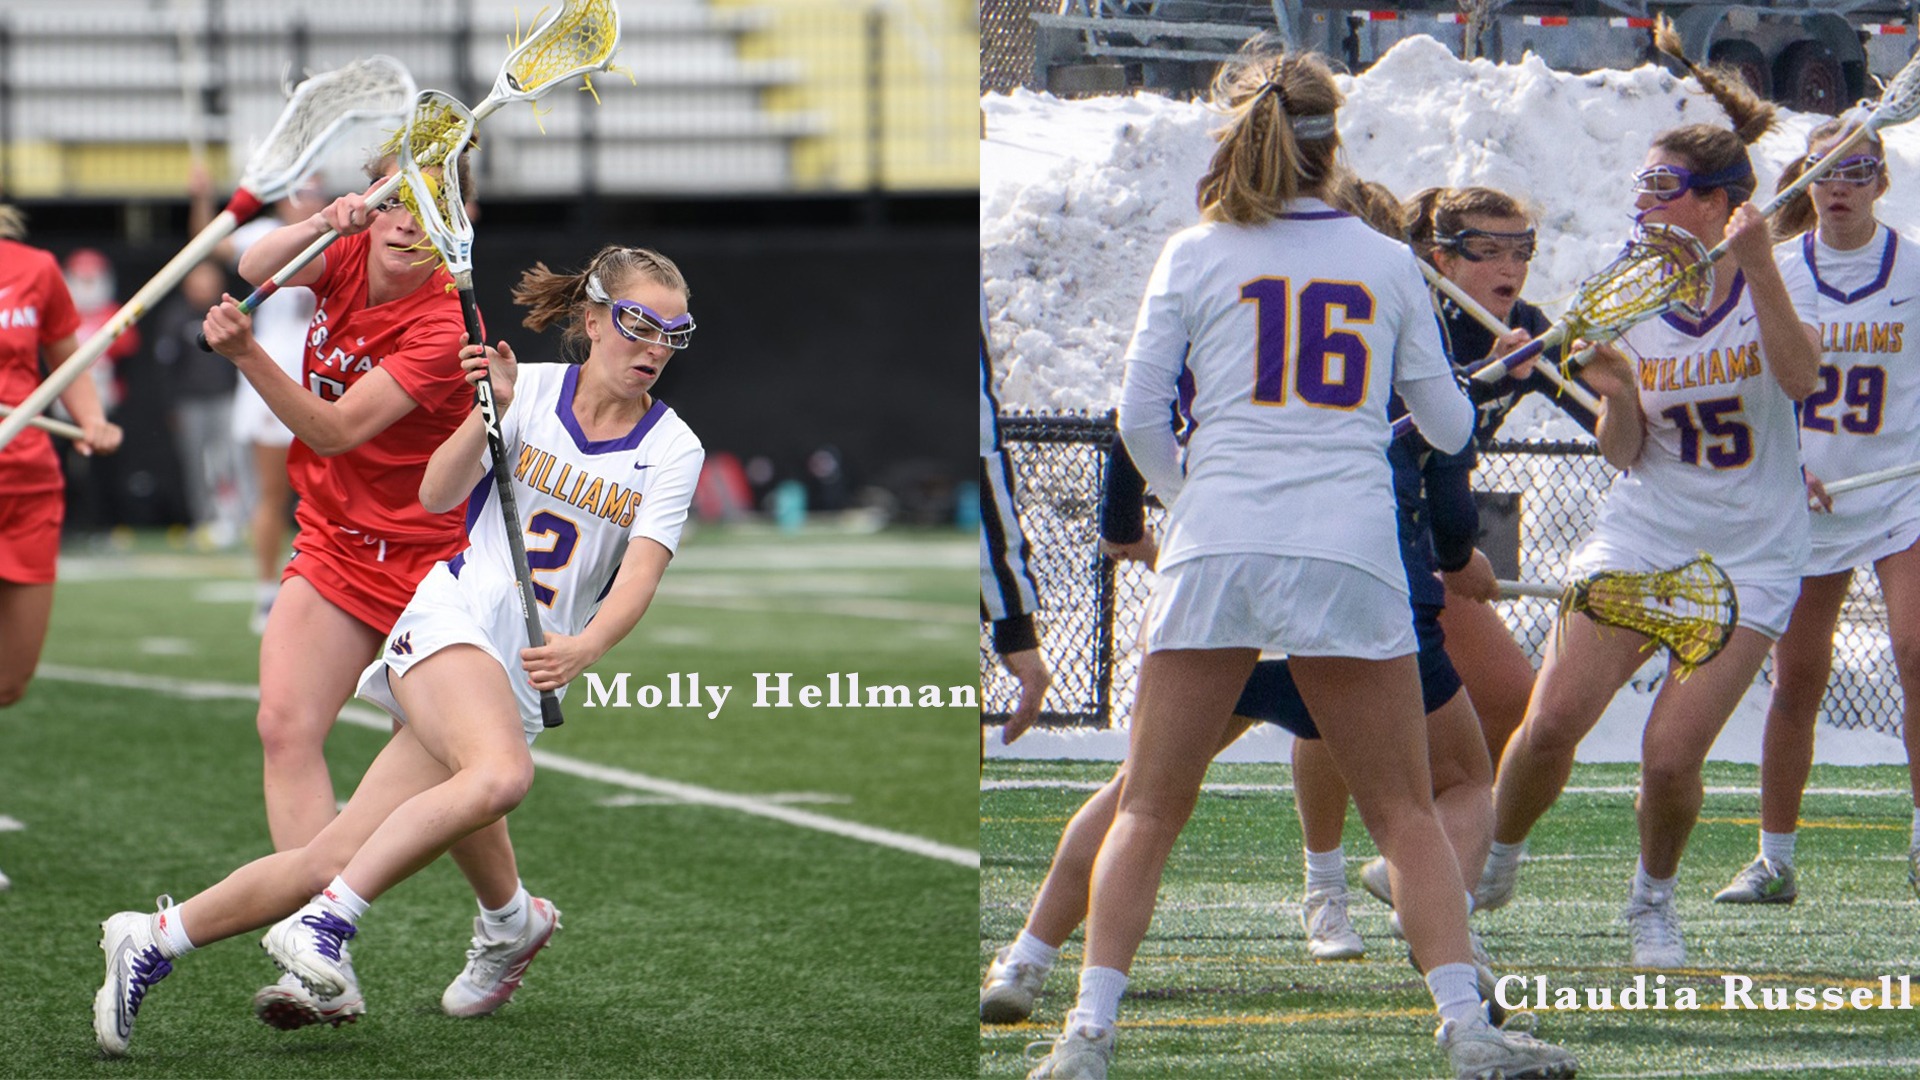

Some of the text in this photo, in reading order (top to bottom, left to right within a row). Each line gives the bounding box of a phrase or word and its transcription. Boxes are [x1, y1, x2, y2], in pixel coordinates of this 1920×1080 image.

[1239, 274, 1377, 412] 16
[1638, 340, 1763, 392] WILLIAMS
[1818, 321, 1904, 354] LLIAMS
[477, 380, 500, 439] STX
[1660, 395, 1755, 470] 15
[1802, 363, 1888, 436] 29
[514, 440, 643, 528] WILLIAMS
[526, 508, 582, 610] 2
